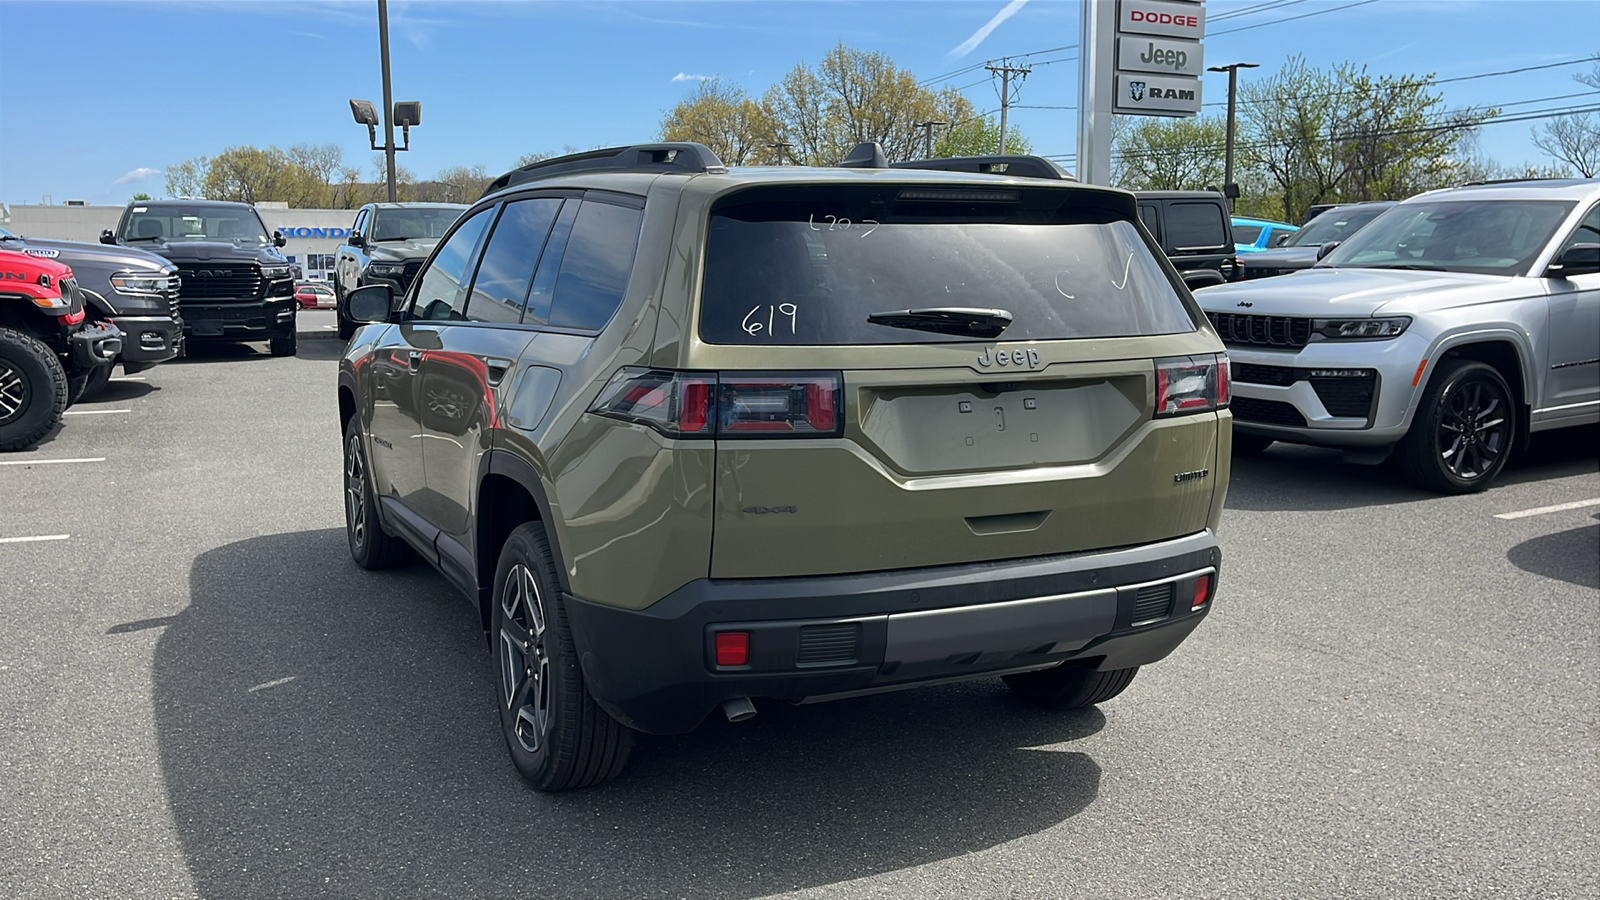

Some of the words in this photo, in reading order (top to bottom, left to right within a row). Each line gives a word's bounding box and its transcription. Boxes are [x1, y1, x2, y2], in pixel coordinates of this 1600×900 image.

[1131, 10, 1198, 27] DODGE
[1140, 42, 1187, 70] Jeep
[1149, 87, 1195, 100] RAM
[742, 302, 798, 337] 619
[978, 346, 1041, 369] Jeep
[1174, 468, 1209, 482] LIMITED
